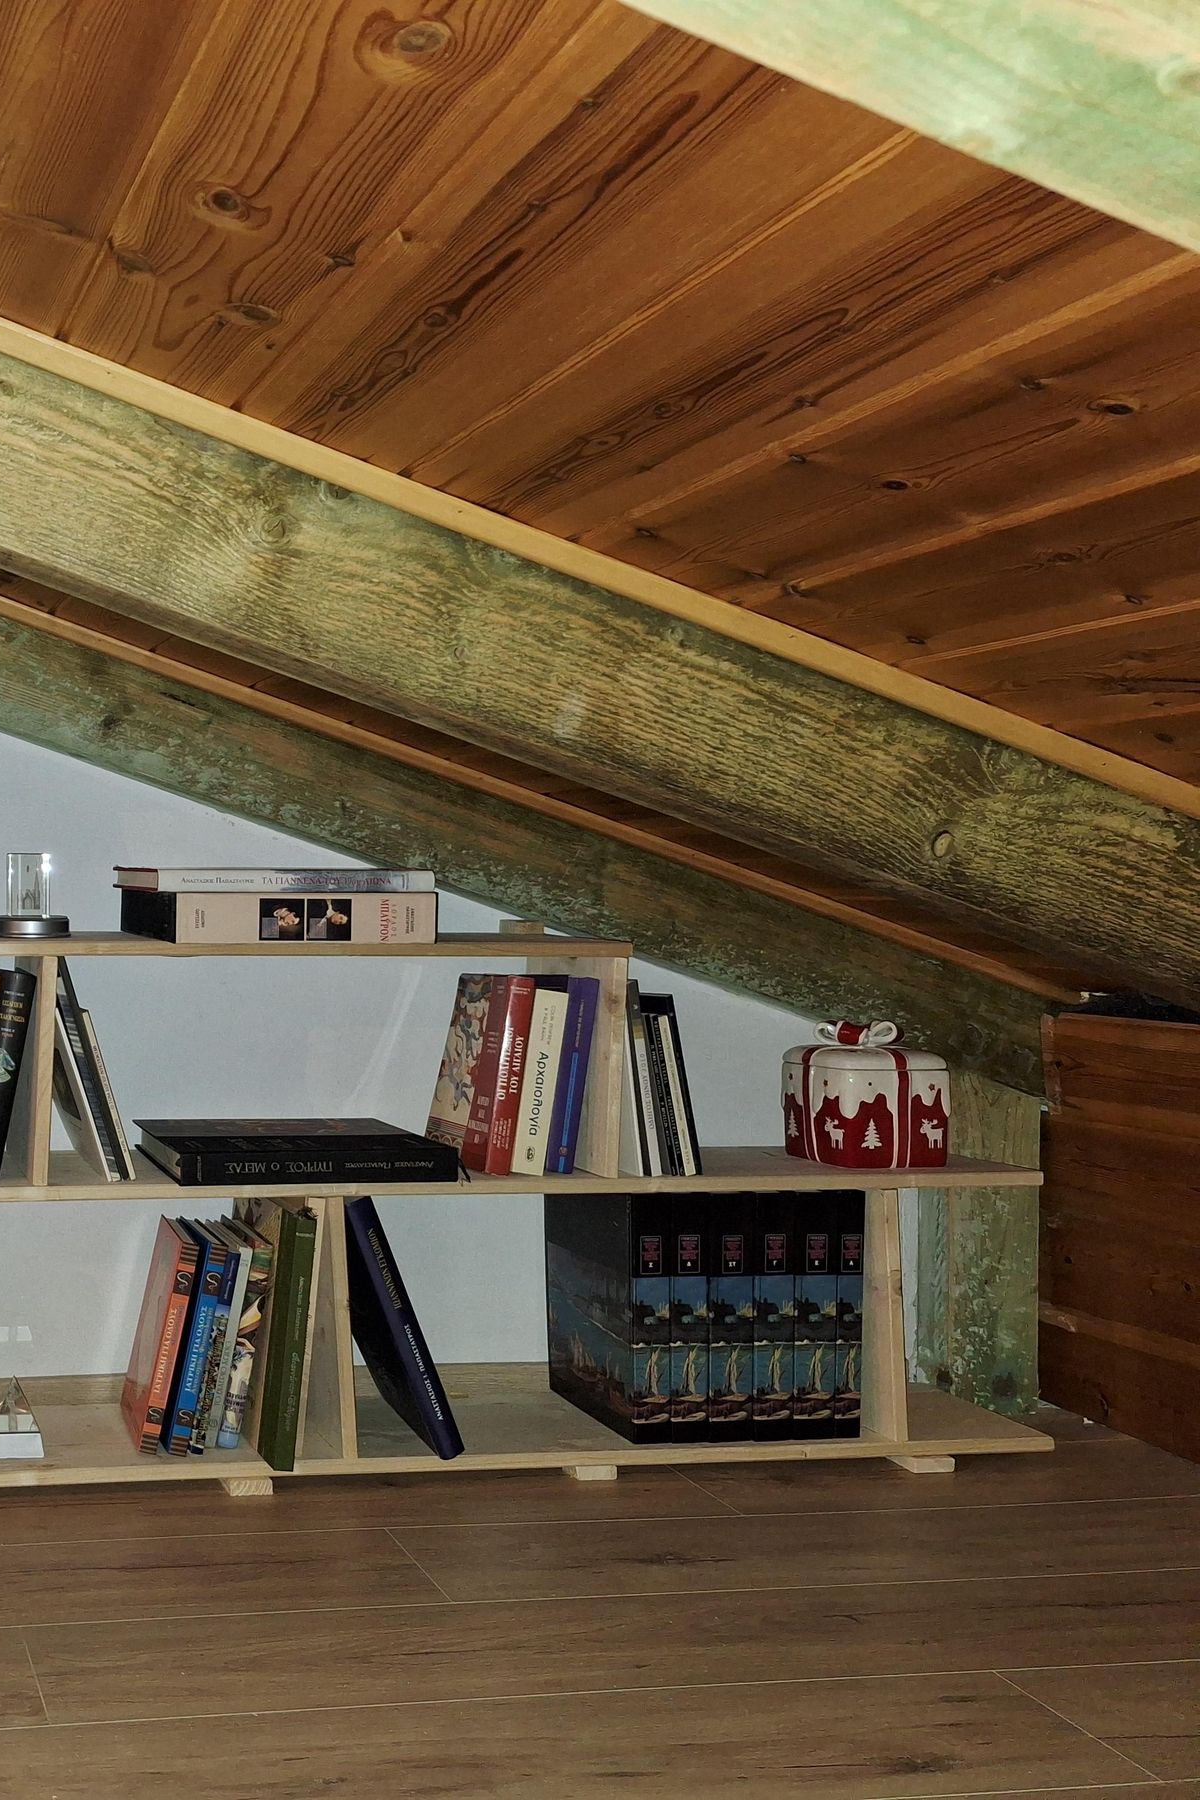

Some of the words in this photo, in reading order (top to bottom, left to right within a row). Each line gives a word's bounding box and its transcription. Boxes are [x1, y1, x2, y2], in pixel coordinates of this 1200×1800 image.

[275, 876, 304, 884] ΓΙΑΝΝΕΝΑ
[512, 1037, 524, 1070] ΑΙΓΑΙΟΥ
[499, 1088, 506, 1099] ΟΙ
[509, 1076, 518, 1092] ΤΟΥ
[529, 1052, 548, 1136] Αρχαιολογία
[225, 1162, 265, 1173] ΜΕΓΑΣ
[286, 1162, 332, 1172] ΠΥΡΡΟΣ
[368, 1228, 386, 1267] ΕΓΚΩΜΙΟΝ
[154, 1356, 167, 1393] ΙΑΤΡΙΚΗ
[162, 1340, 170, 1354] ΓΙΑ
[166, 1309, 177, 1338] ΟΛΟΥΣ
[185, 1354, 197, 1391] ΙΑΤΡΙΚΗ
[197, 1307, 207, 1336] ΟΛΟΥΣ
[404, 1325, 424, 1372] ΠΑΠΑΣΤΑΥΡΟΣ
[424, 1380, 443, 1420] ΑΝΑΣΤΑΣΙΟΣ
